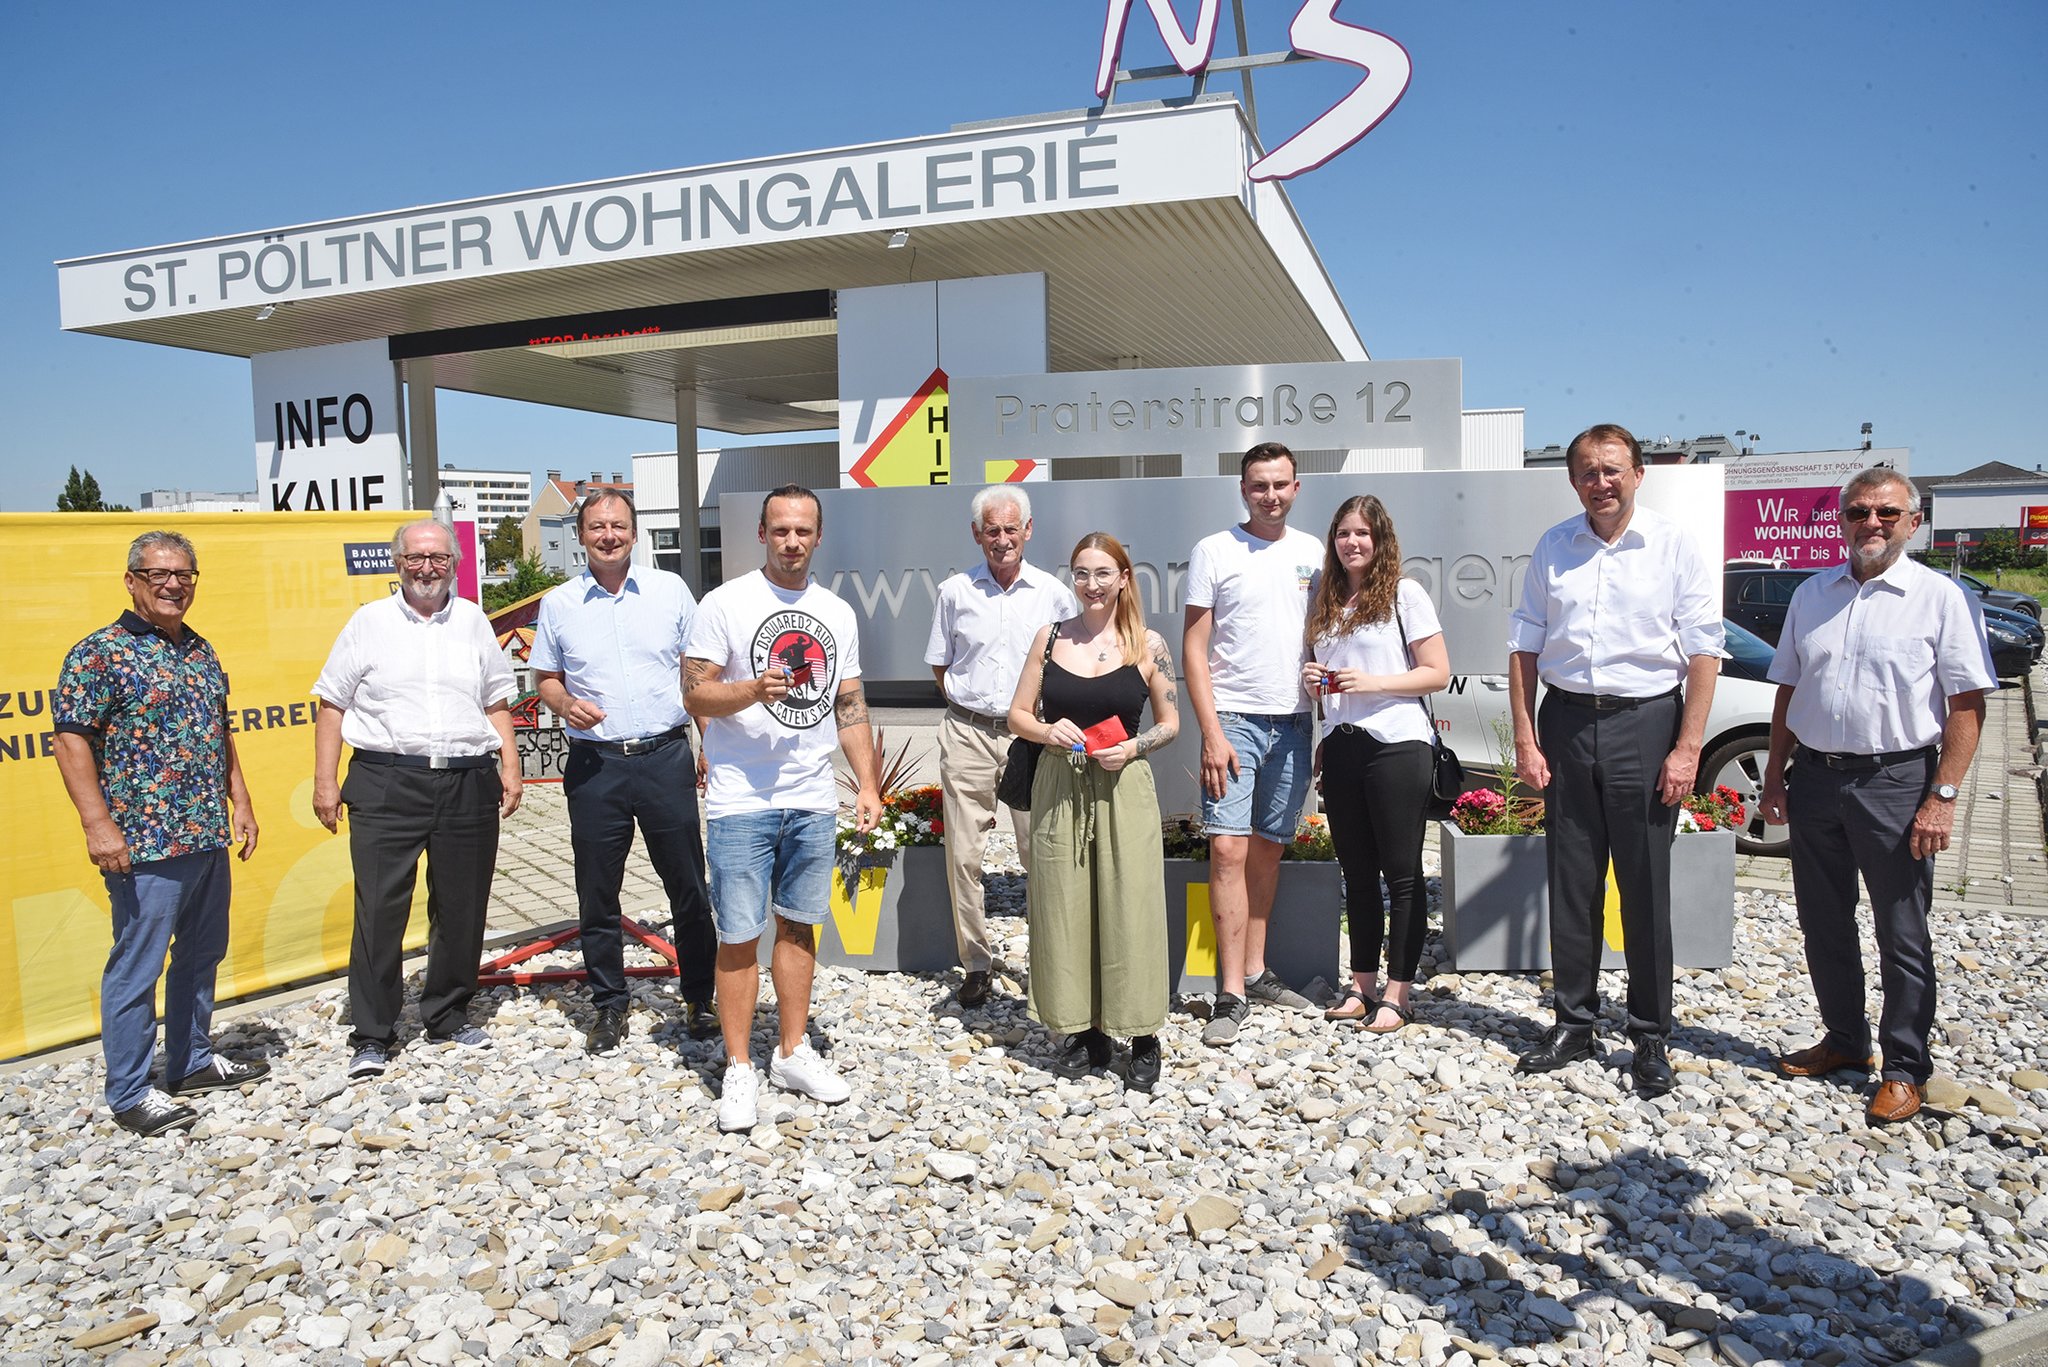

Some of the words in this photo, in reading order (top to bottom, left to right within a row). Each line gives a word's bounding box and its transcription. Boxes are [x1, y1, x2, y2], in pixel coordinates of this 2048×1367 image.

[123, 258, 197, 313] ST.
[218, 215, 493, 300] PÖLTNER
[513, 133, 1120, 261] WOHNGALERIE
[274, 392, 374, 451] INFO
[995, 383, 1338, 437] Praterstraße
[1355, 380, 1412, 424] 12
[271, 474, 385, 512] KAUF
[1740, 549, 1765, 560] von
[1772, 546, 1801, 560] ALT
[1810, 545, 1830, 560] bis
[756, 614, 813, 651] DSQUARED2
[0, 688, 57, 720] ZU
